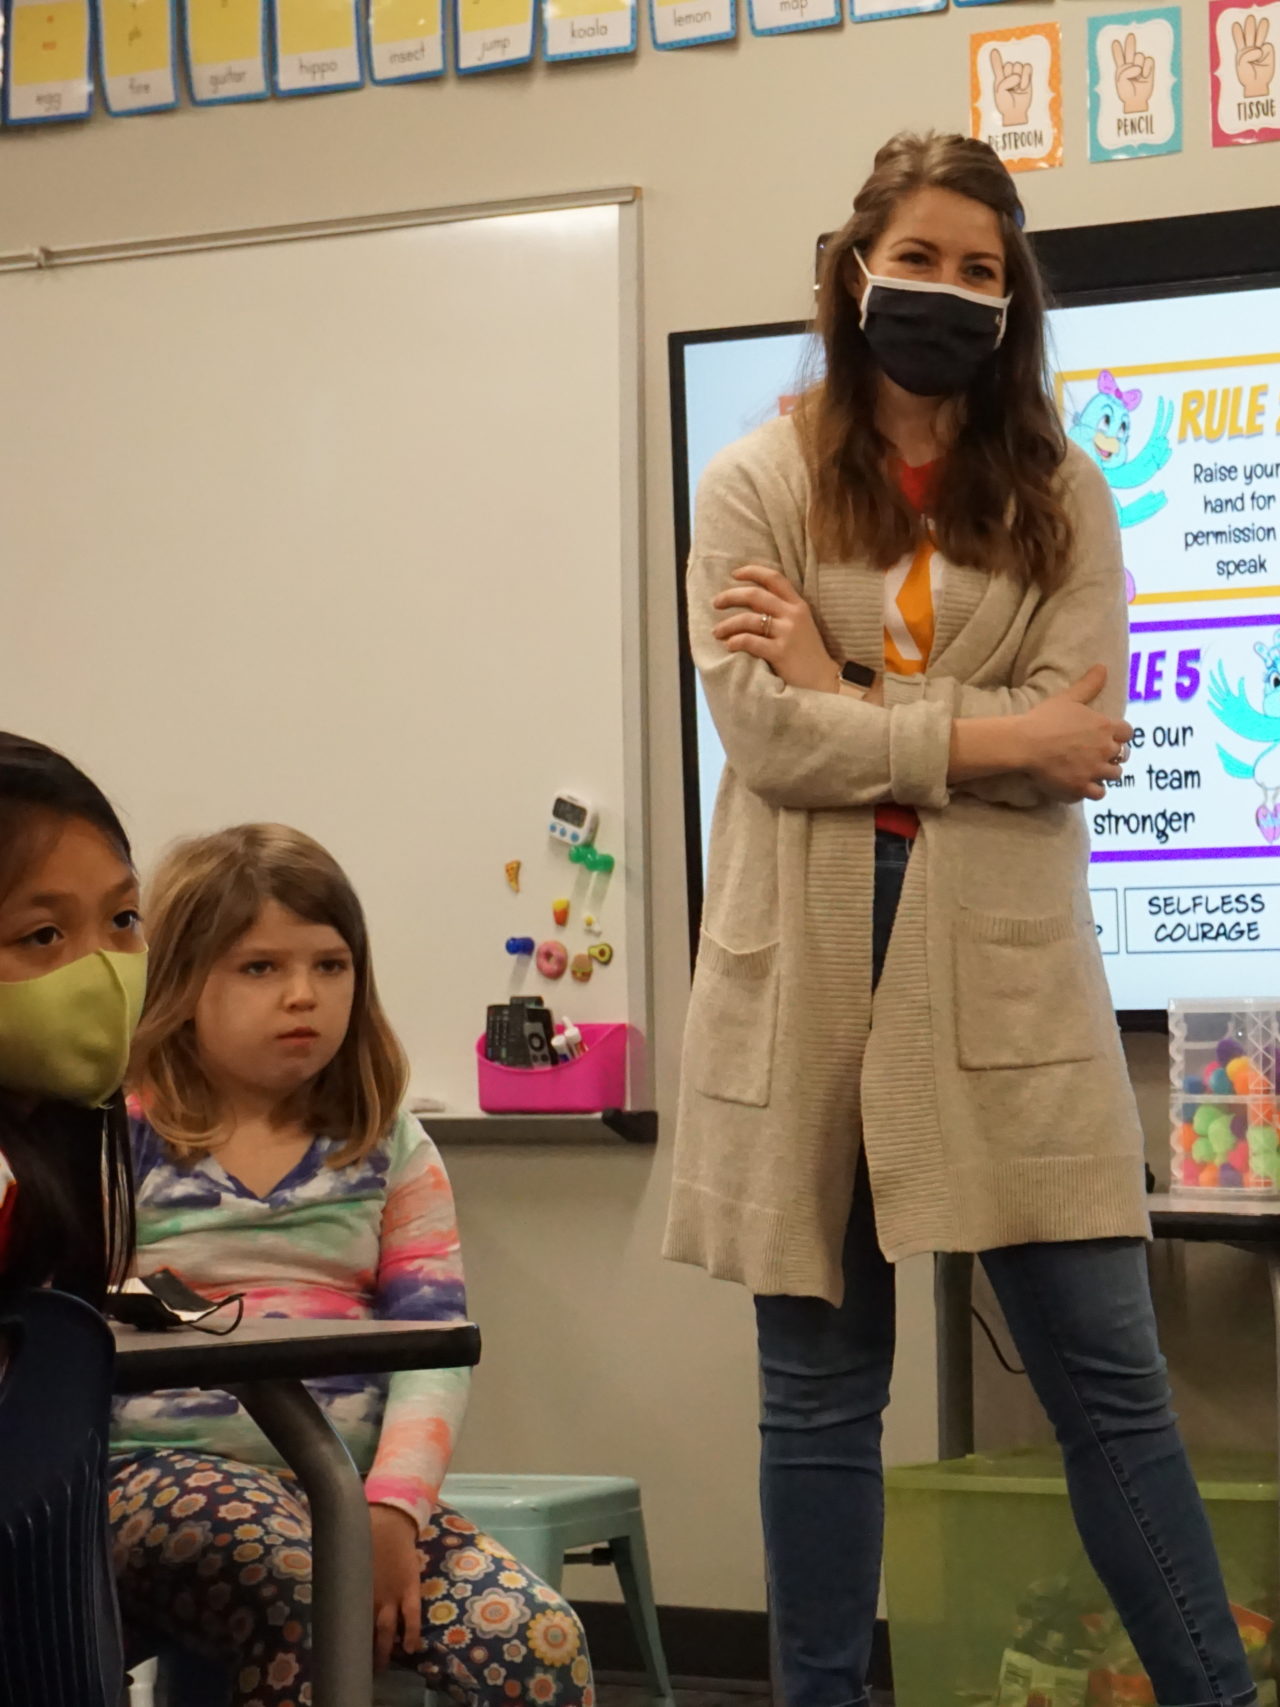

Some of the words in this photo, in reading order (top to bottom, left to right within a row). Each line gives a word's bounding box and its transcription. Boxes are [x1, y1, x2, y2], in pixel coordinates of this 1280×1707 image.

[570, 20, 608, 40] koala
[673, 10, 712, 28] lemon
[389, 41, 425, 64] insect
[477, 37, 511, 61] jump
[299, 58, 338, 80] hippo
[1237, 99, 1276, 121] TISSUE
[1117, 114, 1155, 137] PENCIL
[1178, 384, 1269, 444] RULE
[1193, 463, 1238, 484] Raise
[1203, 493, 1245, 514] hand
[1251, 492, 1276, 511] for
[1184, 524, 1277, 550] permission
[1216, 554, 1267, 579] speak
[1175, 648, 1201, 701] 5
[1153, 725, 1193, 747] our
[1146, 763, 1201, 791] team
[1093, 809, 1196, 844] stronger
[1148, 893, 1265, 915] SELFLESS
[1154, 922, 1260, 943] COURAGE
